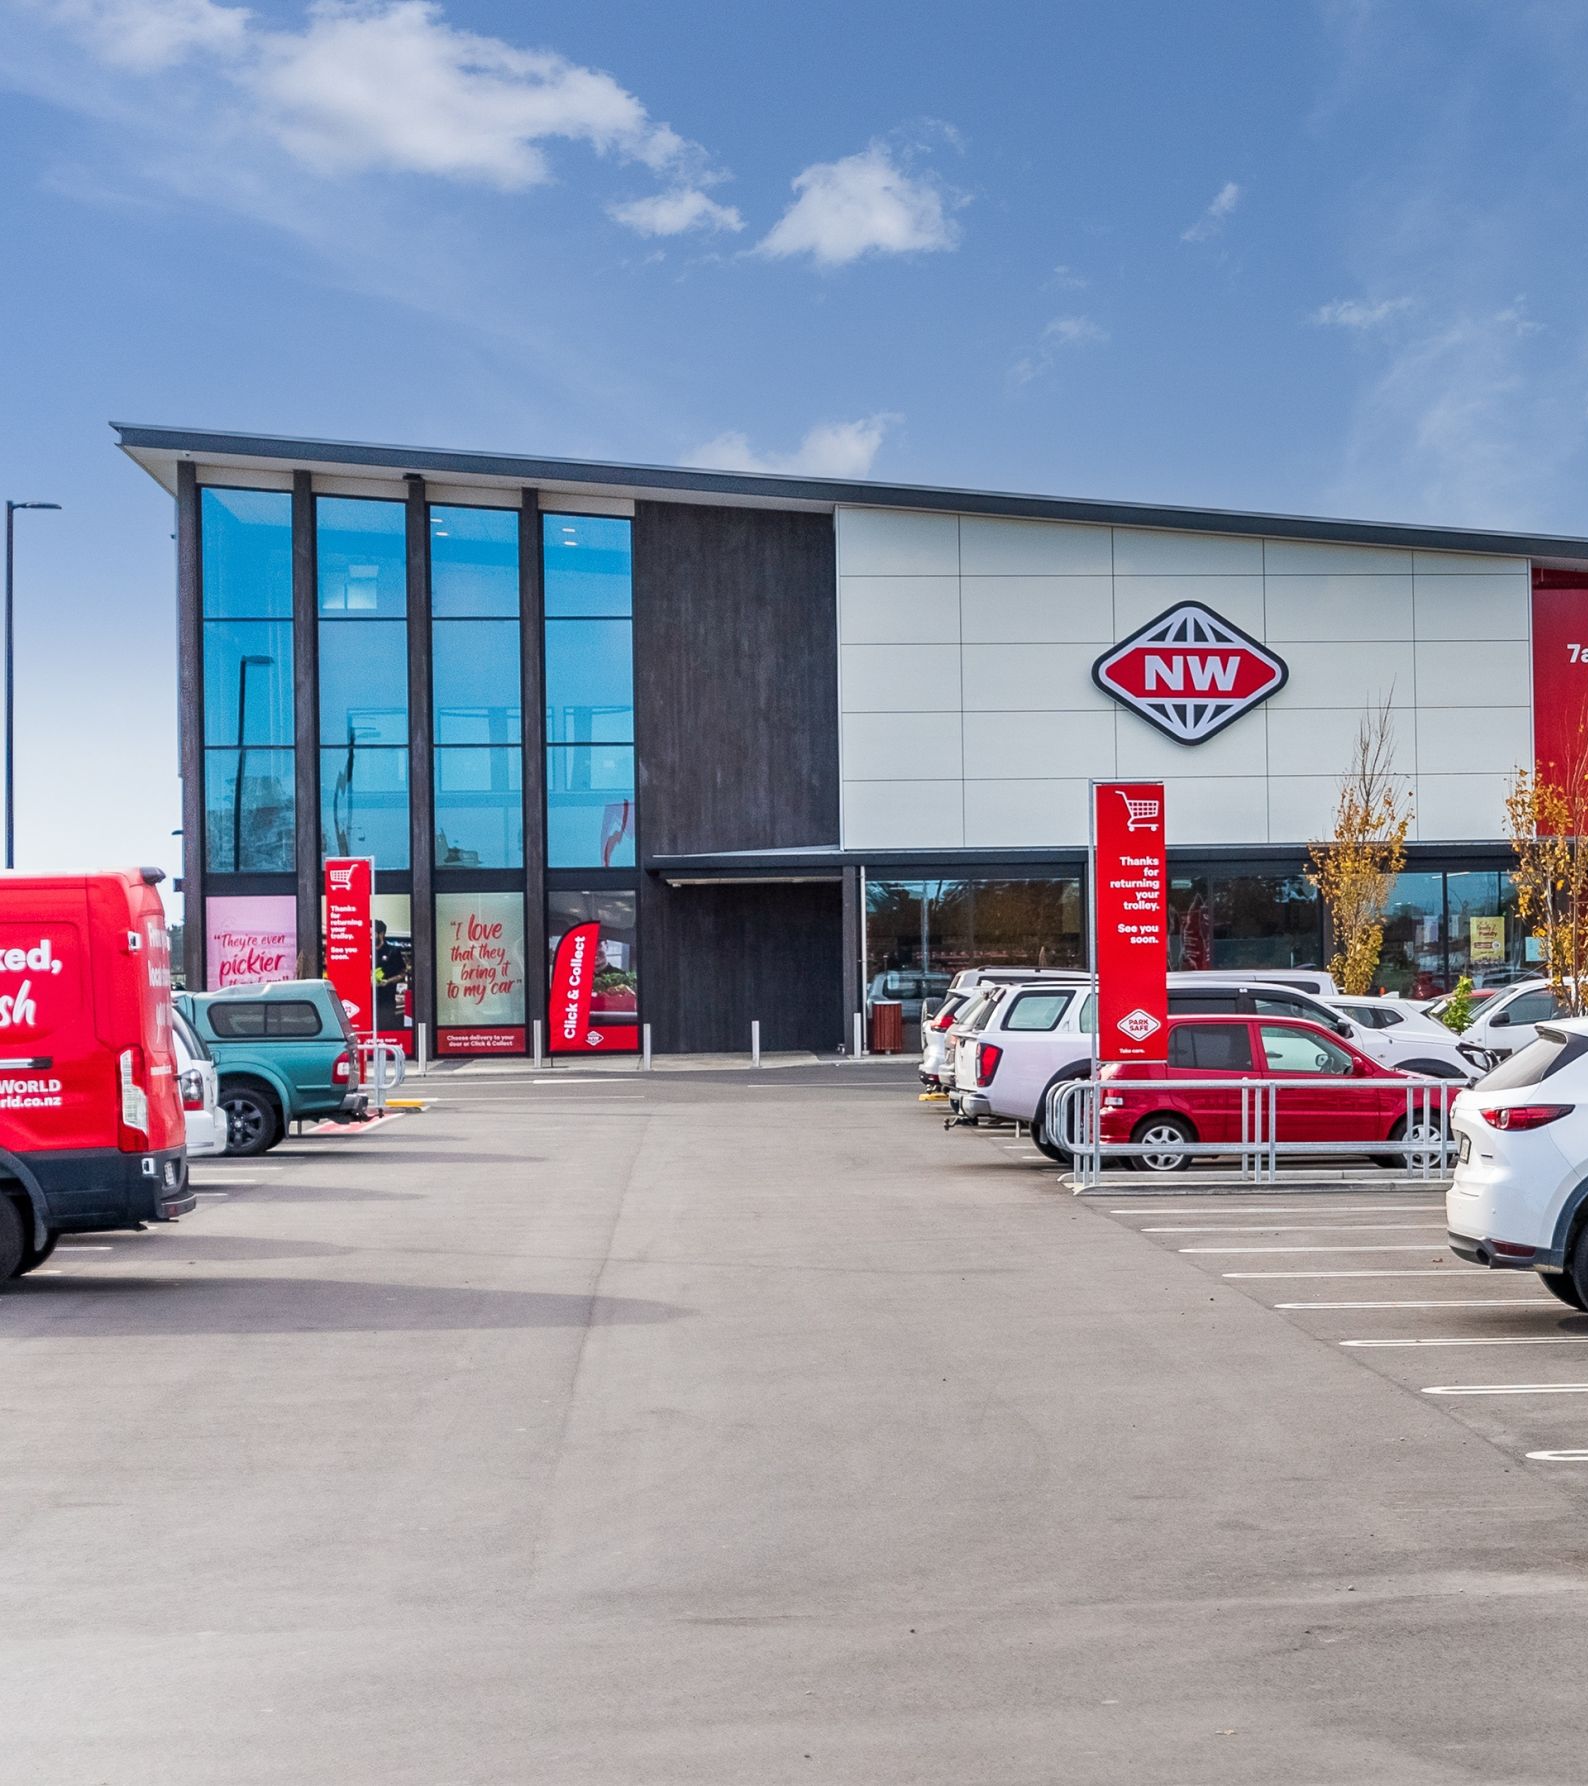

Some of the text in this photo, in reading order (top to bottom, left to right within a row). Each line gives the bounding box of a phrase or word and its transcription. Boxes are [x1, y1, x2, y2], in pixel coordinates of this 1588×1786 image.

[1144, 655, 1241, 691] NW
[1120, 856, 1159, 866] Thanks
[1143, 867, 1159, 876] for
[1110, 878, 1160, 889] returning
[1136, 891, 1160, 901] your
[1123, 901, 1160, 911] trolley.
[330, 919, 363, 927] returning
[468, 913, 503, 941] love
[1118, 924, 1159, 935] See you
[261, 934, 286, 945] even
[1130, 936, 1159, 944] soon.
[0, 939, 63, 974] ed,
[450, 943, 506, 966] that they
[219, 948, 286, 986] pickier
[461, 960, 511, 984] bring it
[446, 980, 460, 999] to
[463, 984, 486, 1005] my
[564, 935, 586, 1039] Click & Collect
